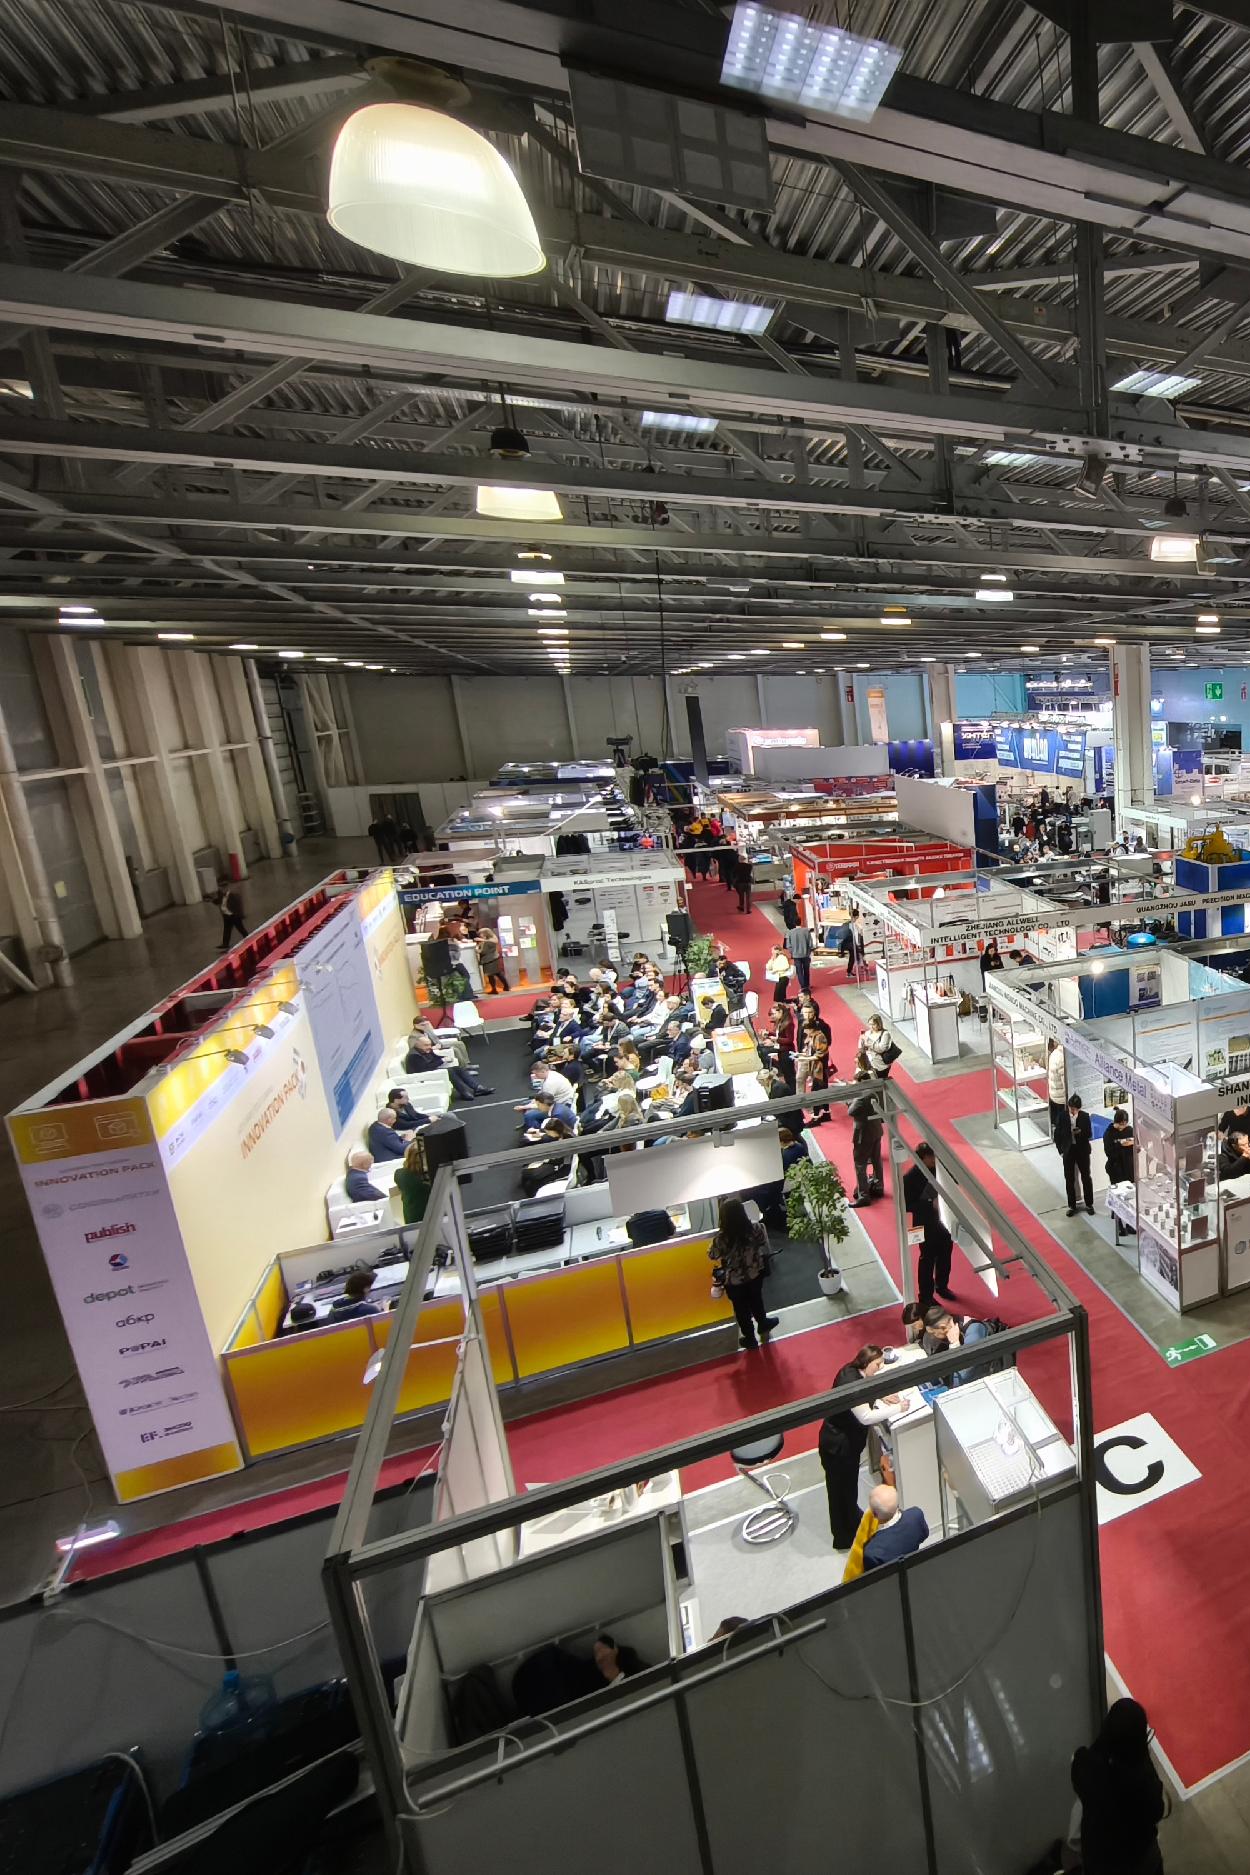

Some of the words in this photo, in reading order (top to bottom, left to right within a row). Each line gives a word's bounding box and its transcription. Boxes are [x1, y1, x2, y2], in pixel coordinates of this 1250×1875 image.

[403, 888, 472, 902] EDUCATION
[474, 885, 510, 896] POINT
[930, 931, 982, 945] INTELLIGENT
[983, 925, 1037, 939] TECHNOLOGY
[965, 921, 1005, 932] ZHEJIANG
[1094, 1053, 1124, 1082] Alliance
[1124, 1073, 1147, 1099] Metal
[241, 1093, 286, 1160] INNOVATION
[34, 1168, 119, 1187] INNOVATION
[121, 1161, 155, 1172] PACK
[84, 1222, 137, 1244] publish
[83, 1285, 136, 1304] depot
[1092, 1435, 1165, 1496] C
